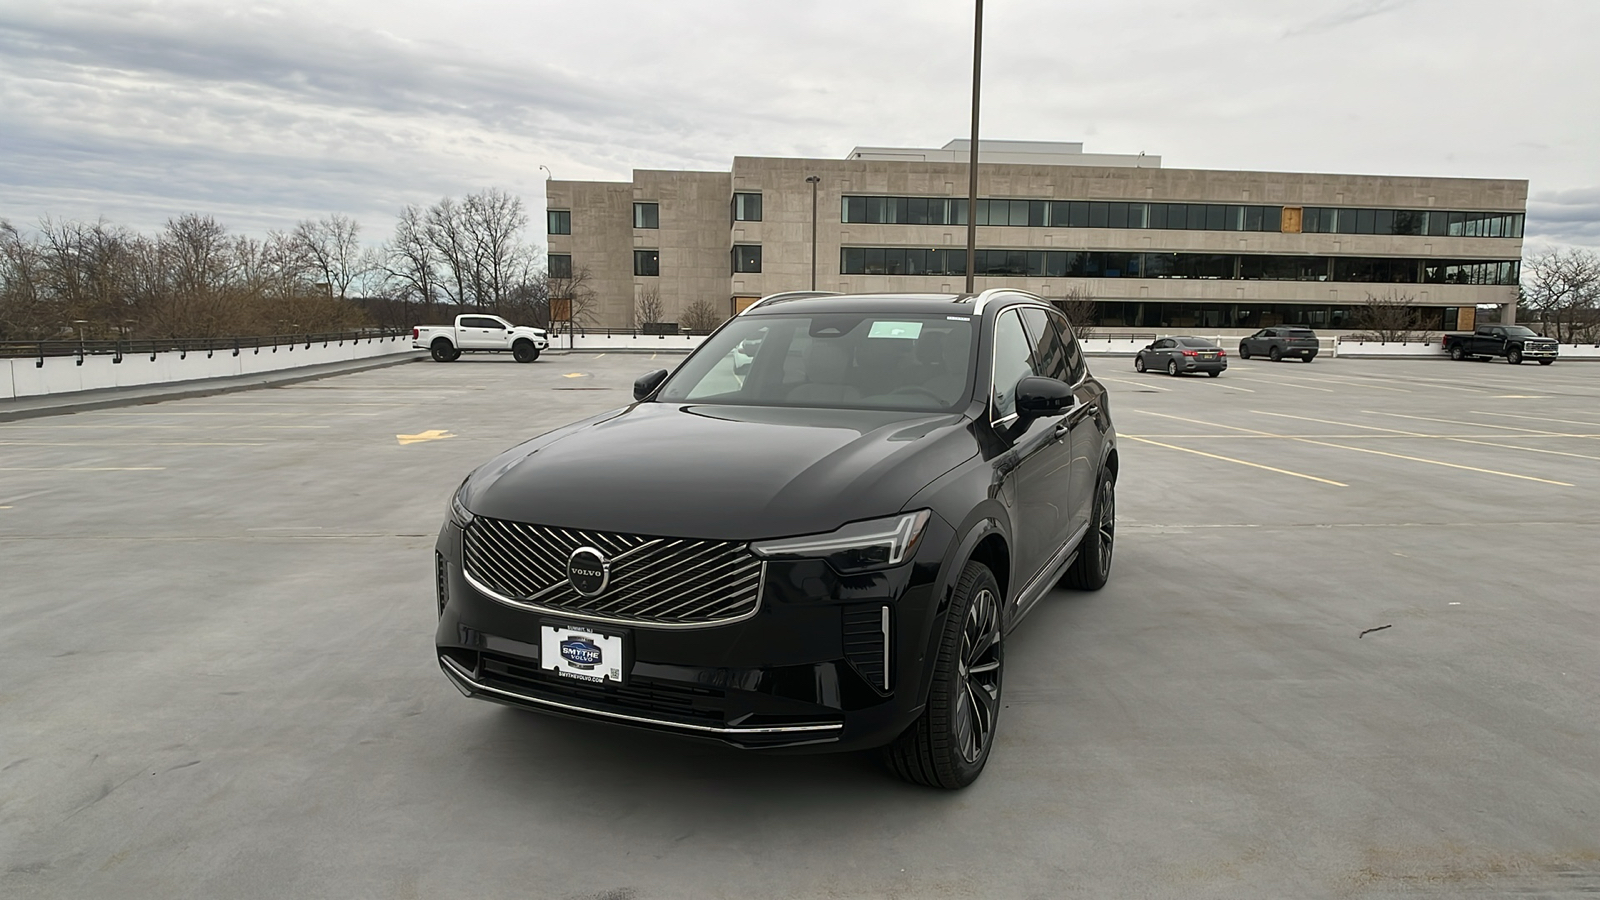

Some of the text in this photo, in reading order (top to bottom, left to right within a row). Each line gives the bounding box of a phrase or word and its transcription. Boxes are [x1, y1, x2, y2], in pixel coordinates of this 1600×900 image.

[571, 568, 601, 577] VOLVO
[562, 647, 599, 659] SMYTHE
[558, 671, 603, 683] SMYTHEVOLVO.COM
